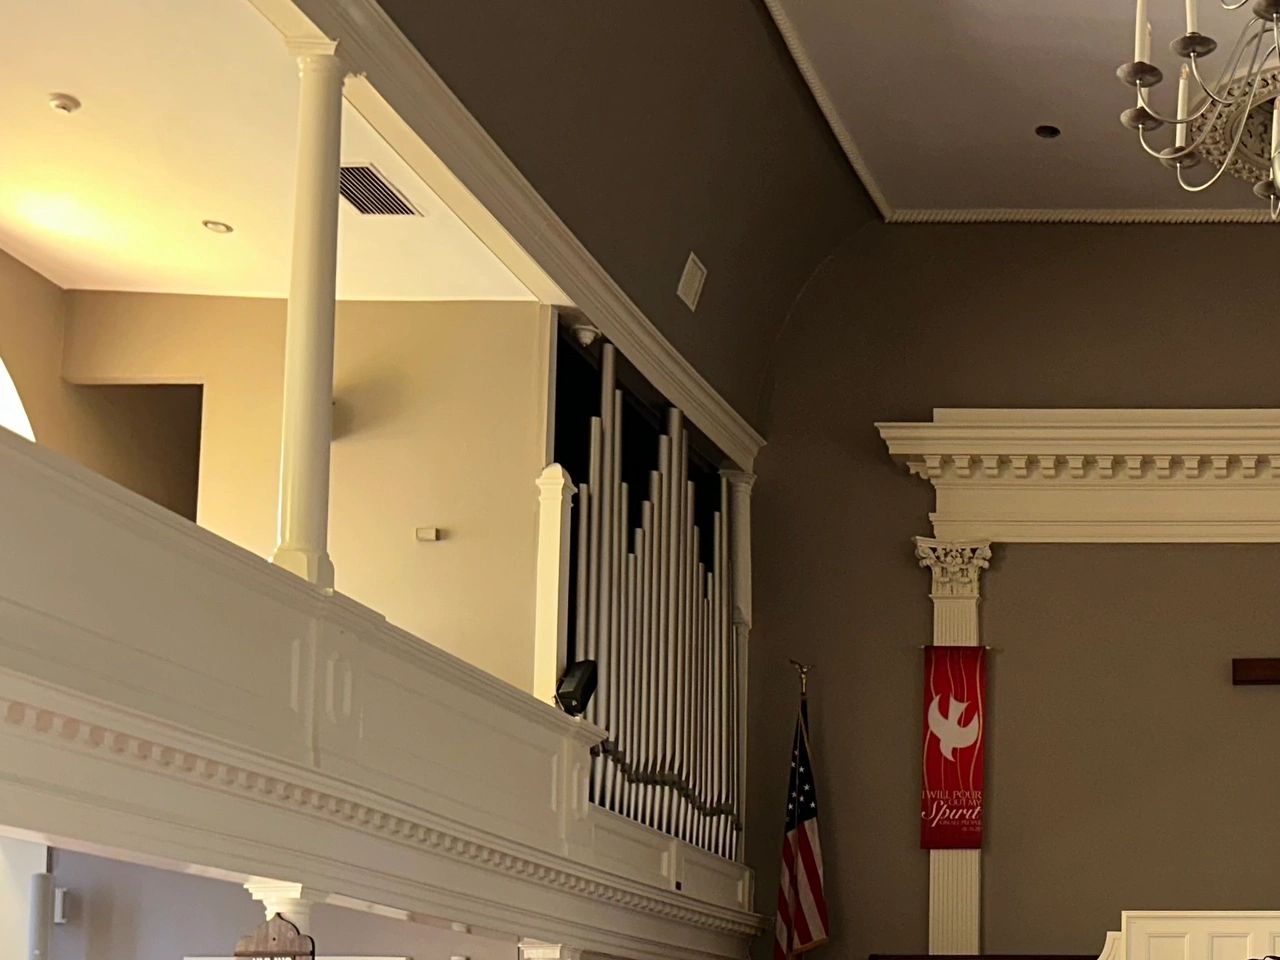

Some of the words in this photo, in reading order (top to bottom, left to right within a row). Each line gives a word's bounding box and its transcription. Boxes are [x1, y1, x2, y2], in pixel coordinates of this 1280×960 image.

[926, 790, 949, 799] WILL
[953, 790, 982, 799] POUR
[968, 799, 982, 807] MY
[921, 800, 982, 827] Spirit
